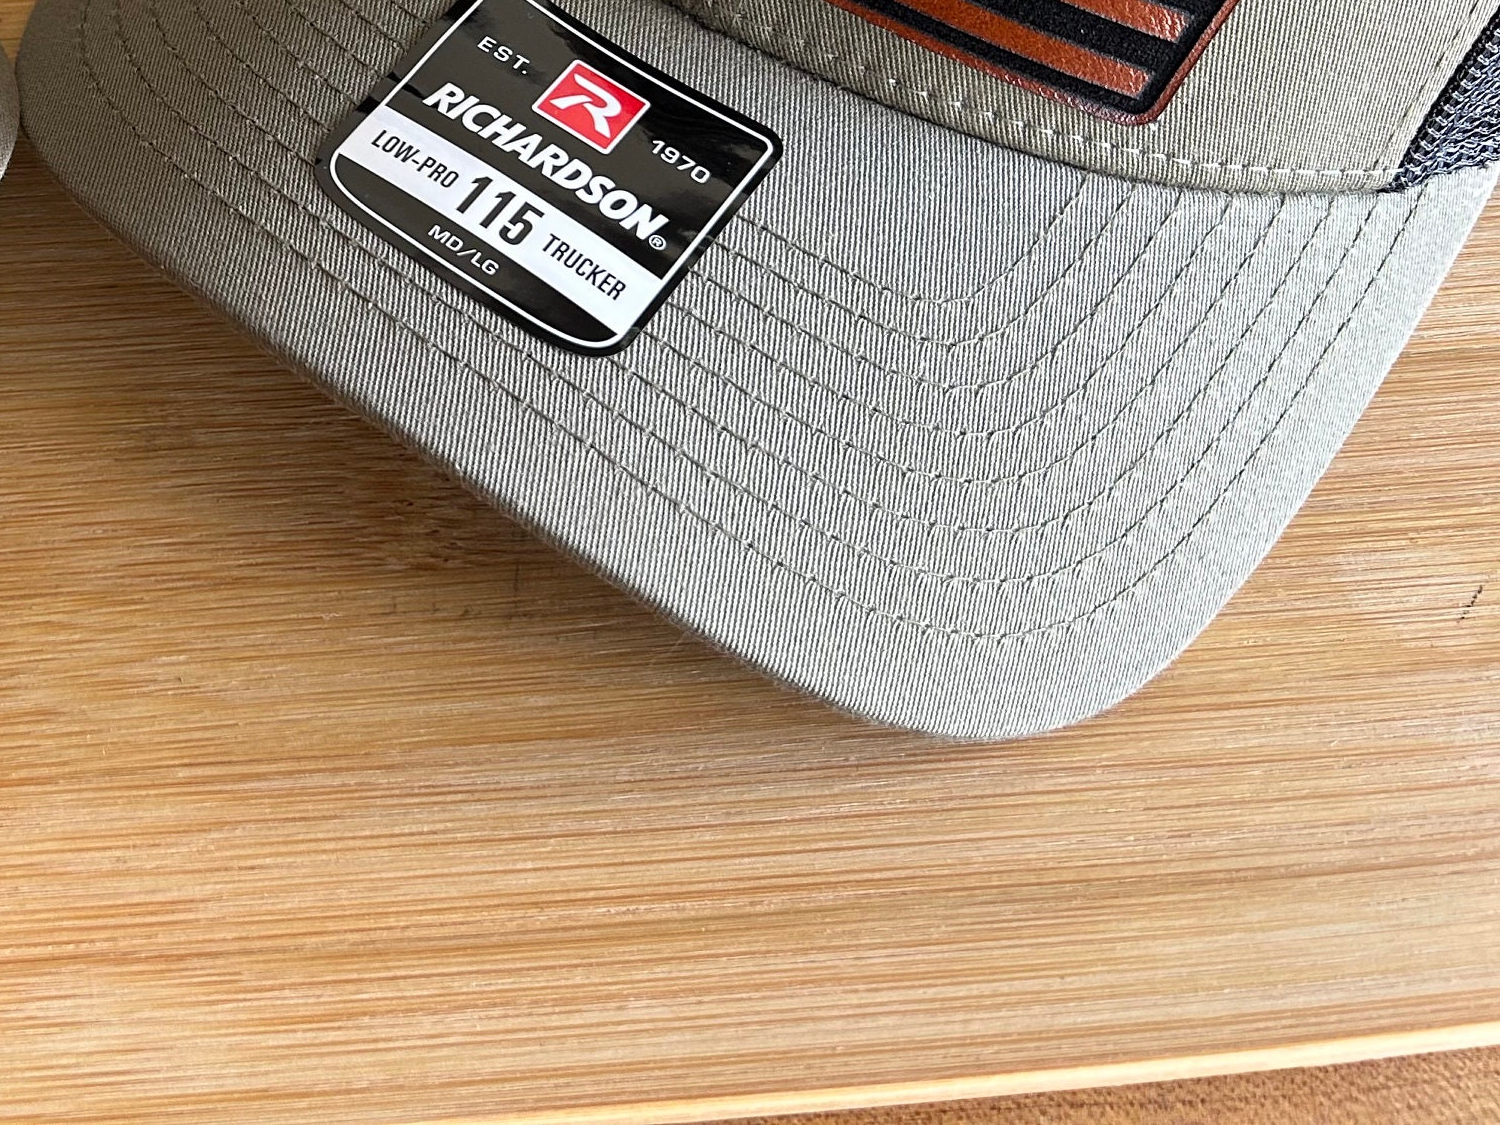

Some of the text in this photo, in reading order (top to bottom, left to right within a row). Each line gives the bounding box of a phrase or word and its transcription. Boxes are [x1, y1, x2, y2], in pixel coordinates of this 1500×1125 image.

[477, 36, 529, 75] EST.
[651, 139, 711, 184] 1970
[371, 129, 627, 302] LOW-PRO 115 TRUCKER
[428, 223, 500, 276] MD/LG
